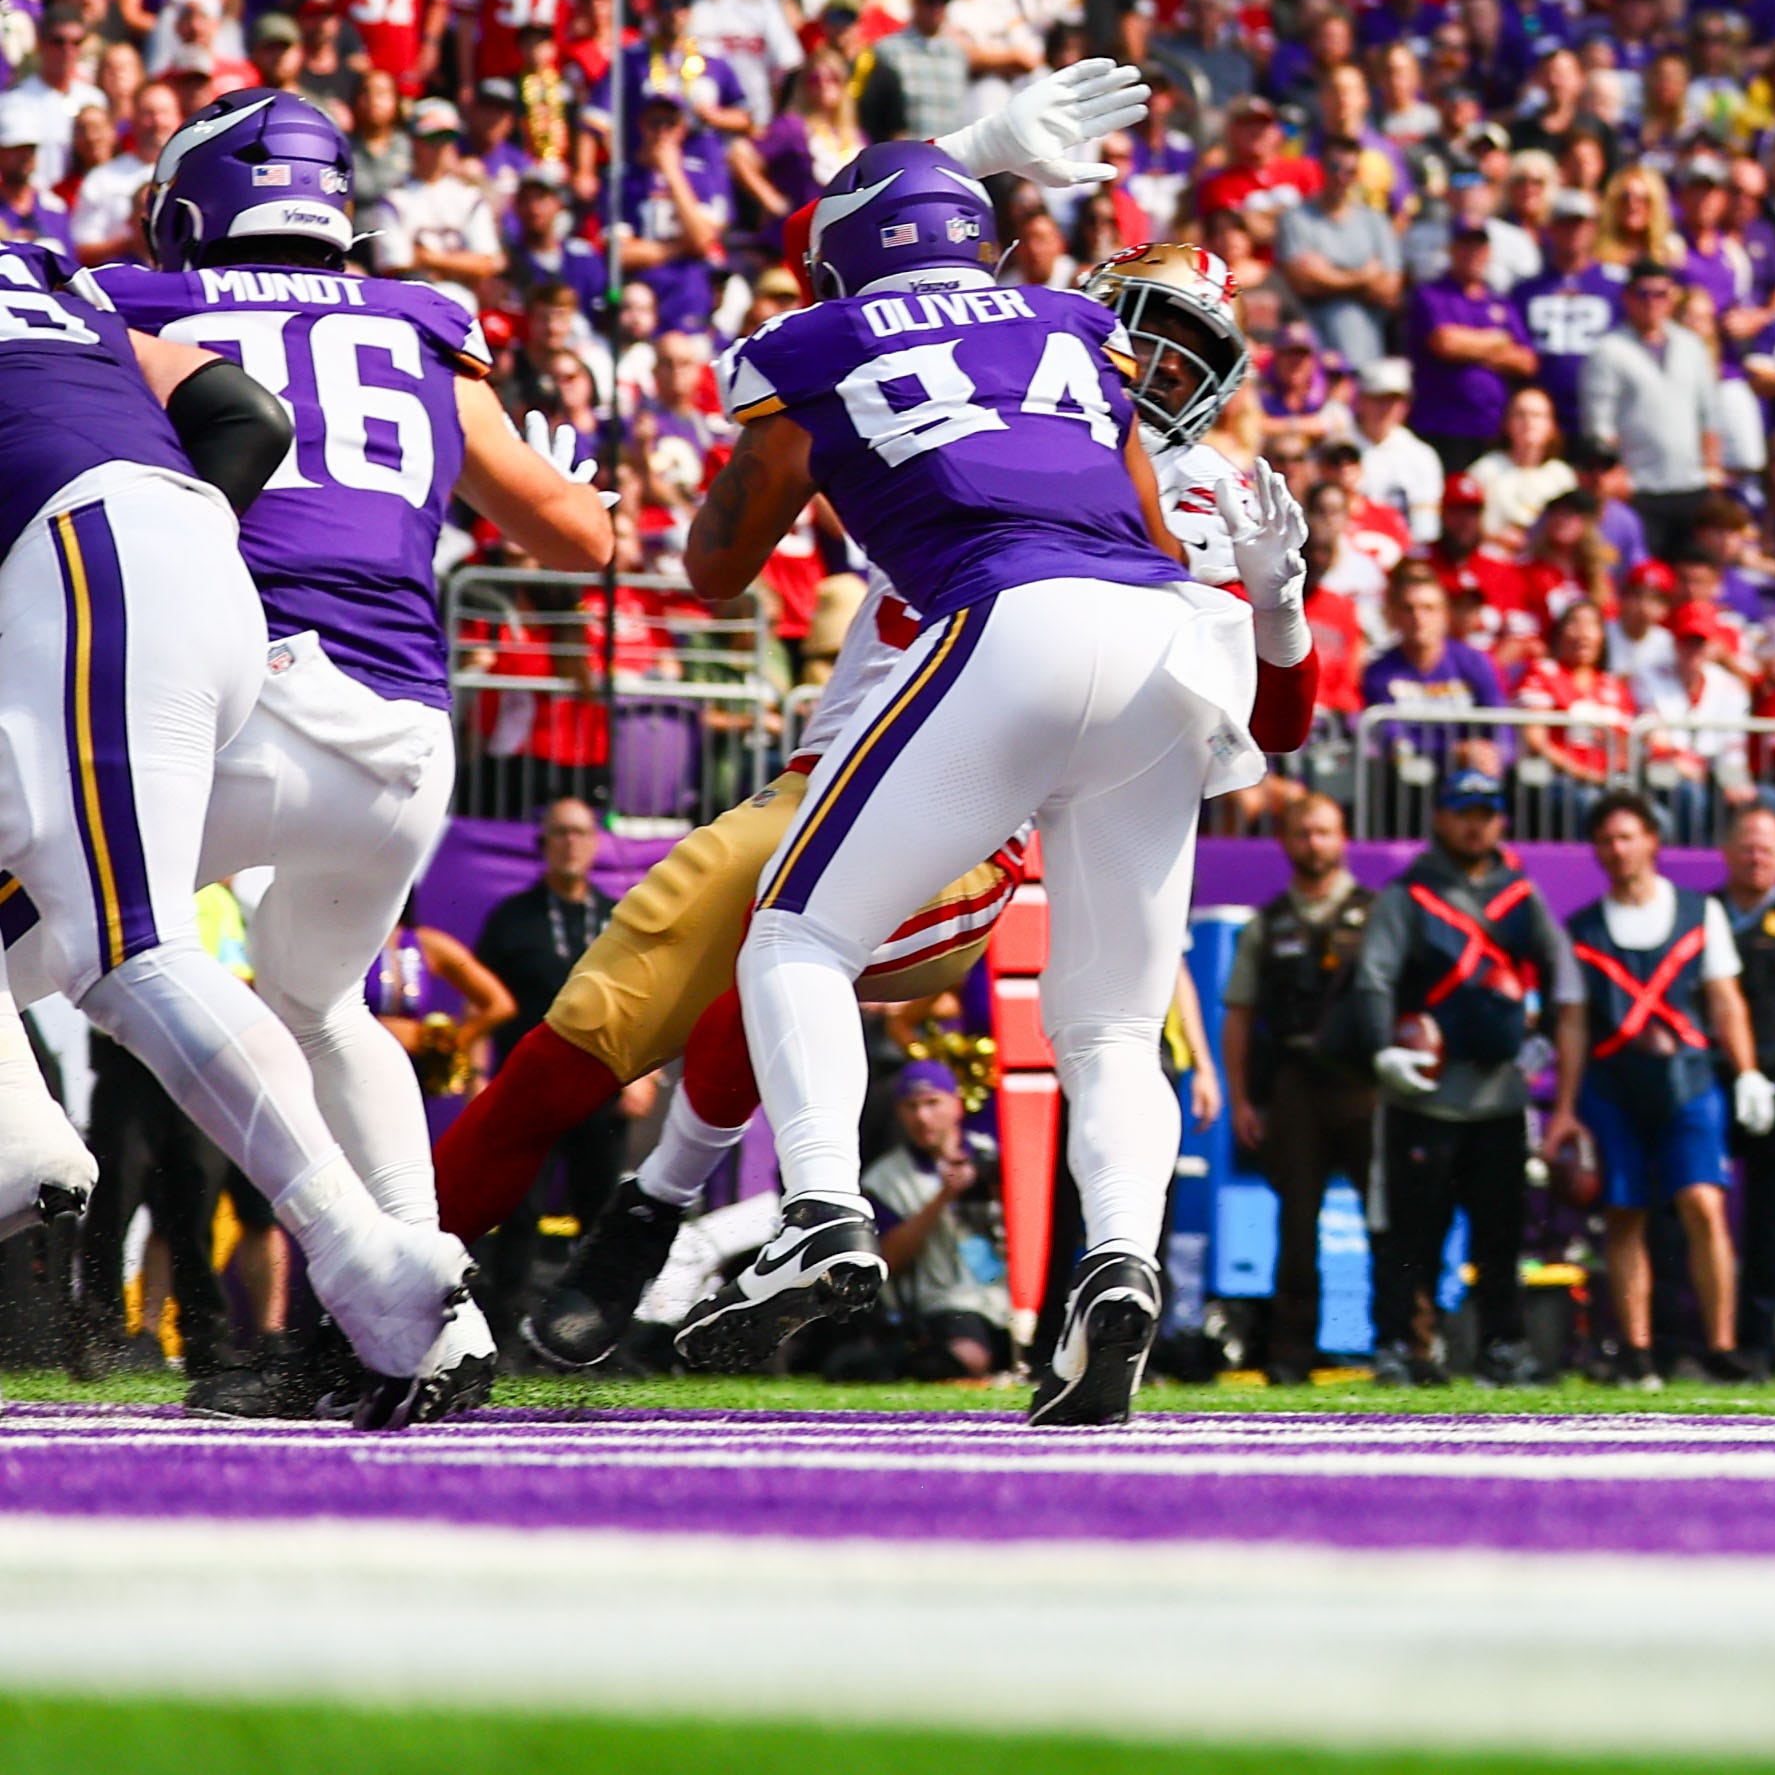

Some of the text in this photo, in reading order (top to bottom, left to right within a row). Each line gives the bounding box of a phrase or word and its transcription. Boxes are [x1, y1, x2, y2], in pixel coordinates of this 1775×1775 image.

[200, 267, 367, 307] MUNDT
[860, 288, 1037, 338] OLIVER
[835, 330, 1121, 468] 84
